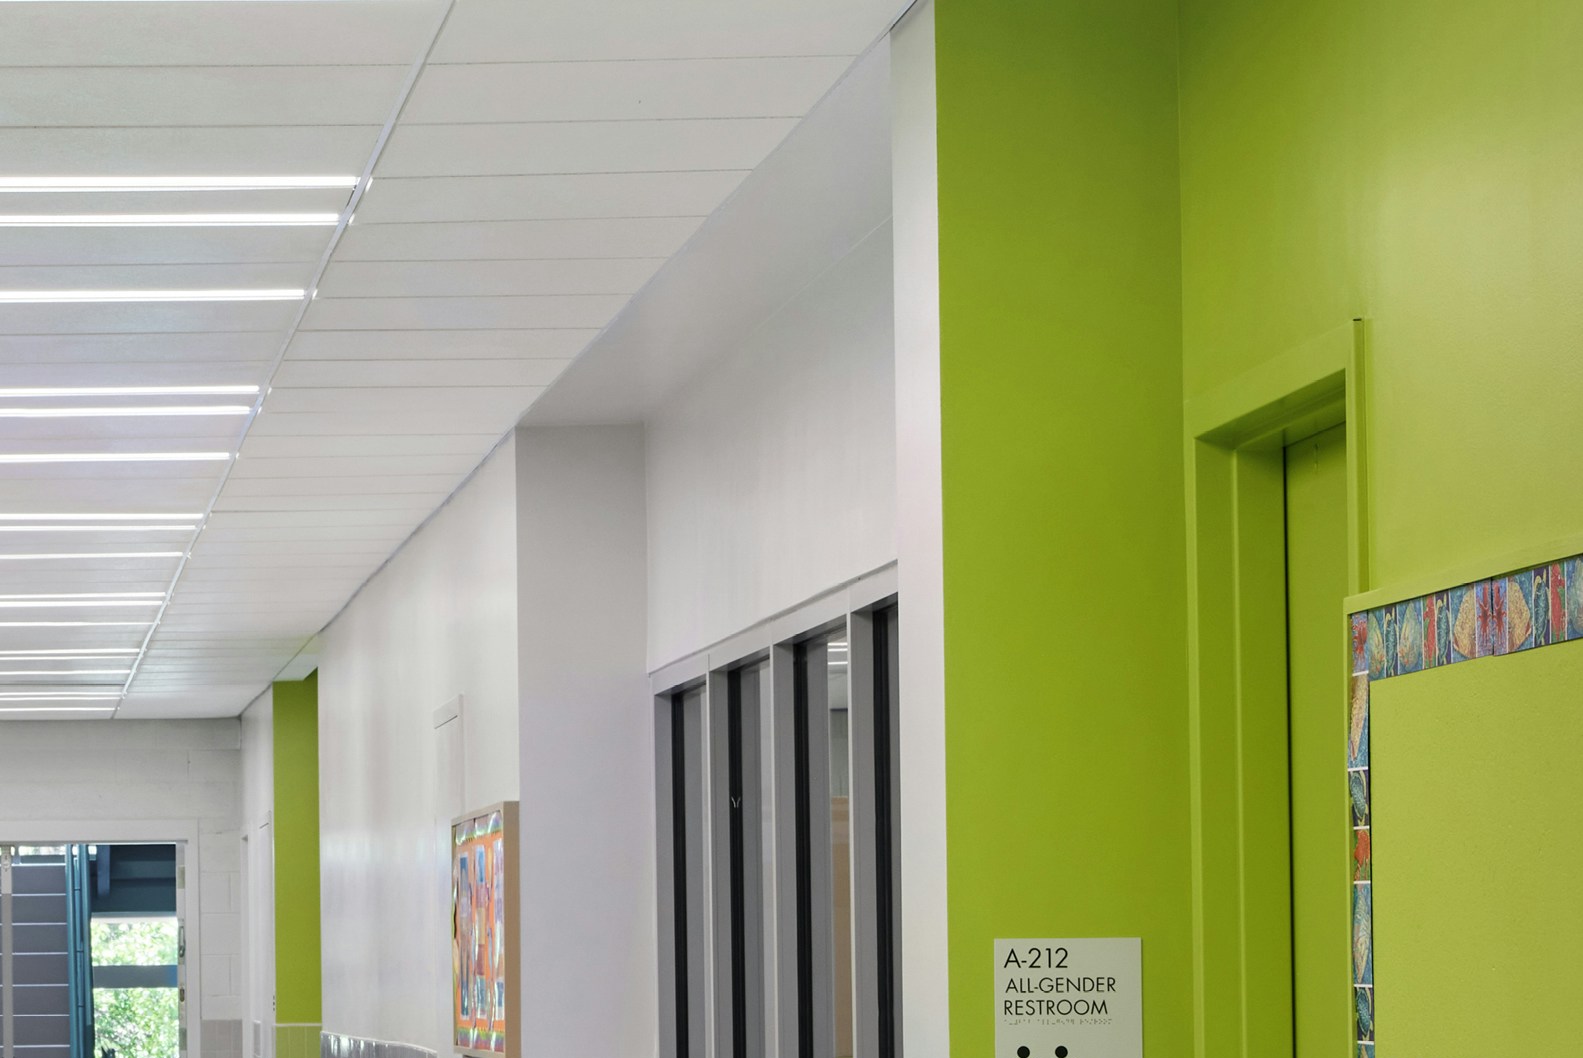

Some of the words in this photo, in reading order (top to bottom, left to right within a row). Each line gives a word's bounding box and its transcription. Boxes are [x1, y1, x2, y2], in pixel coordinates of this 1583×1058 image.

[1004, 947, 1068, 969] A-212
[1005, 977, 1117, 994] ALL-GENDER
[1003, 999, 1108, 1016] RESTROOM
